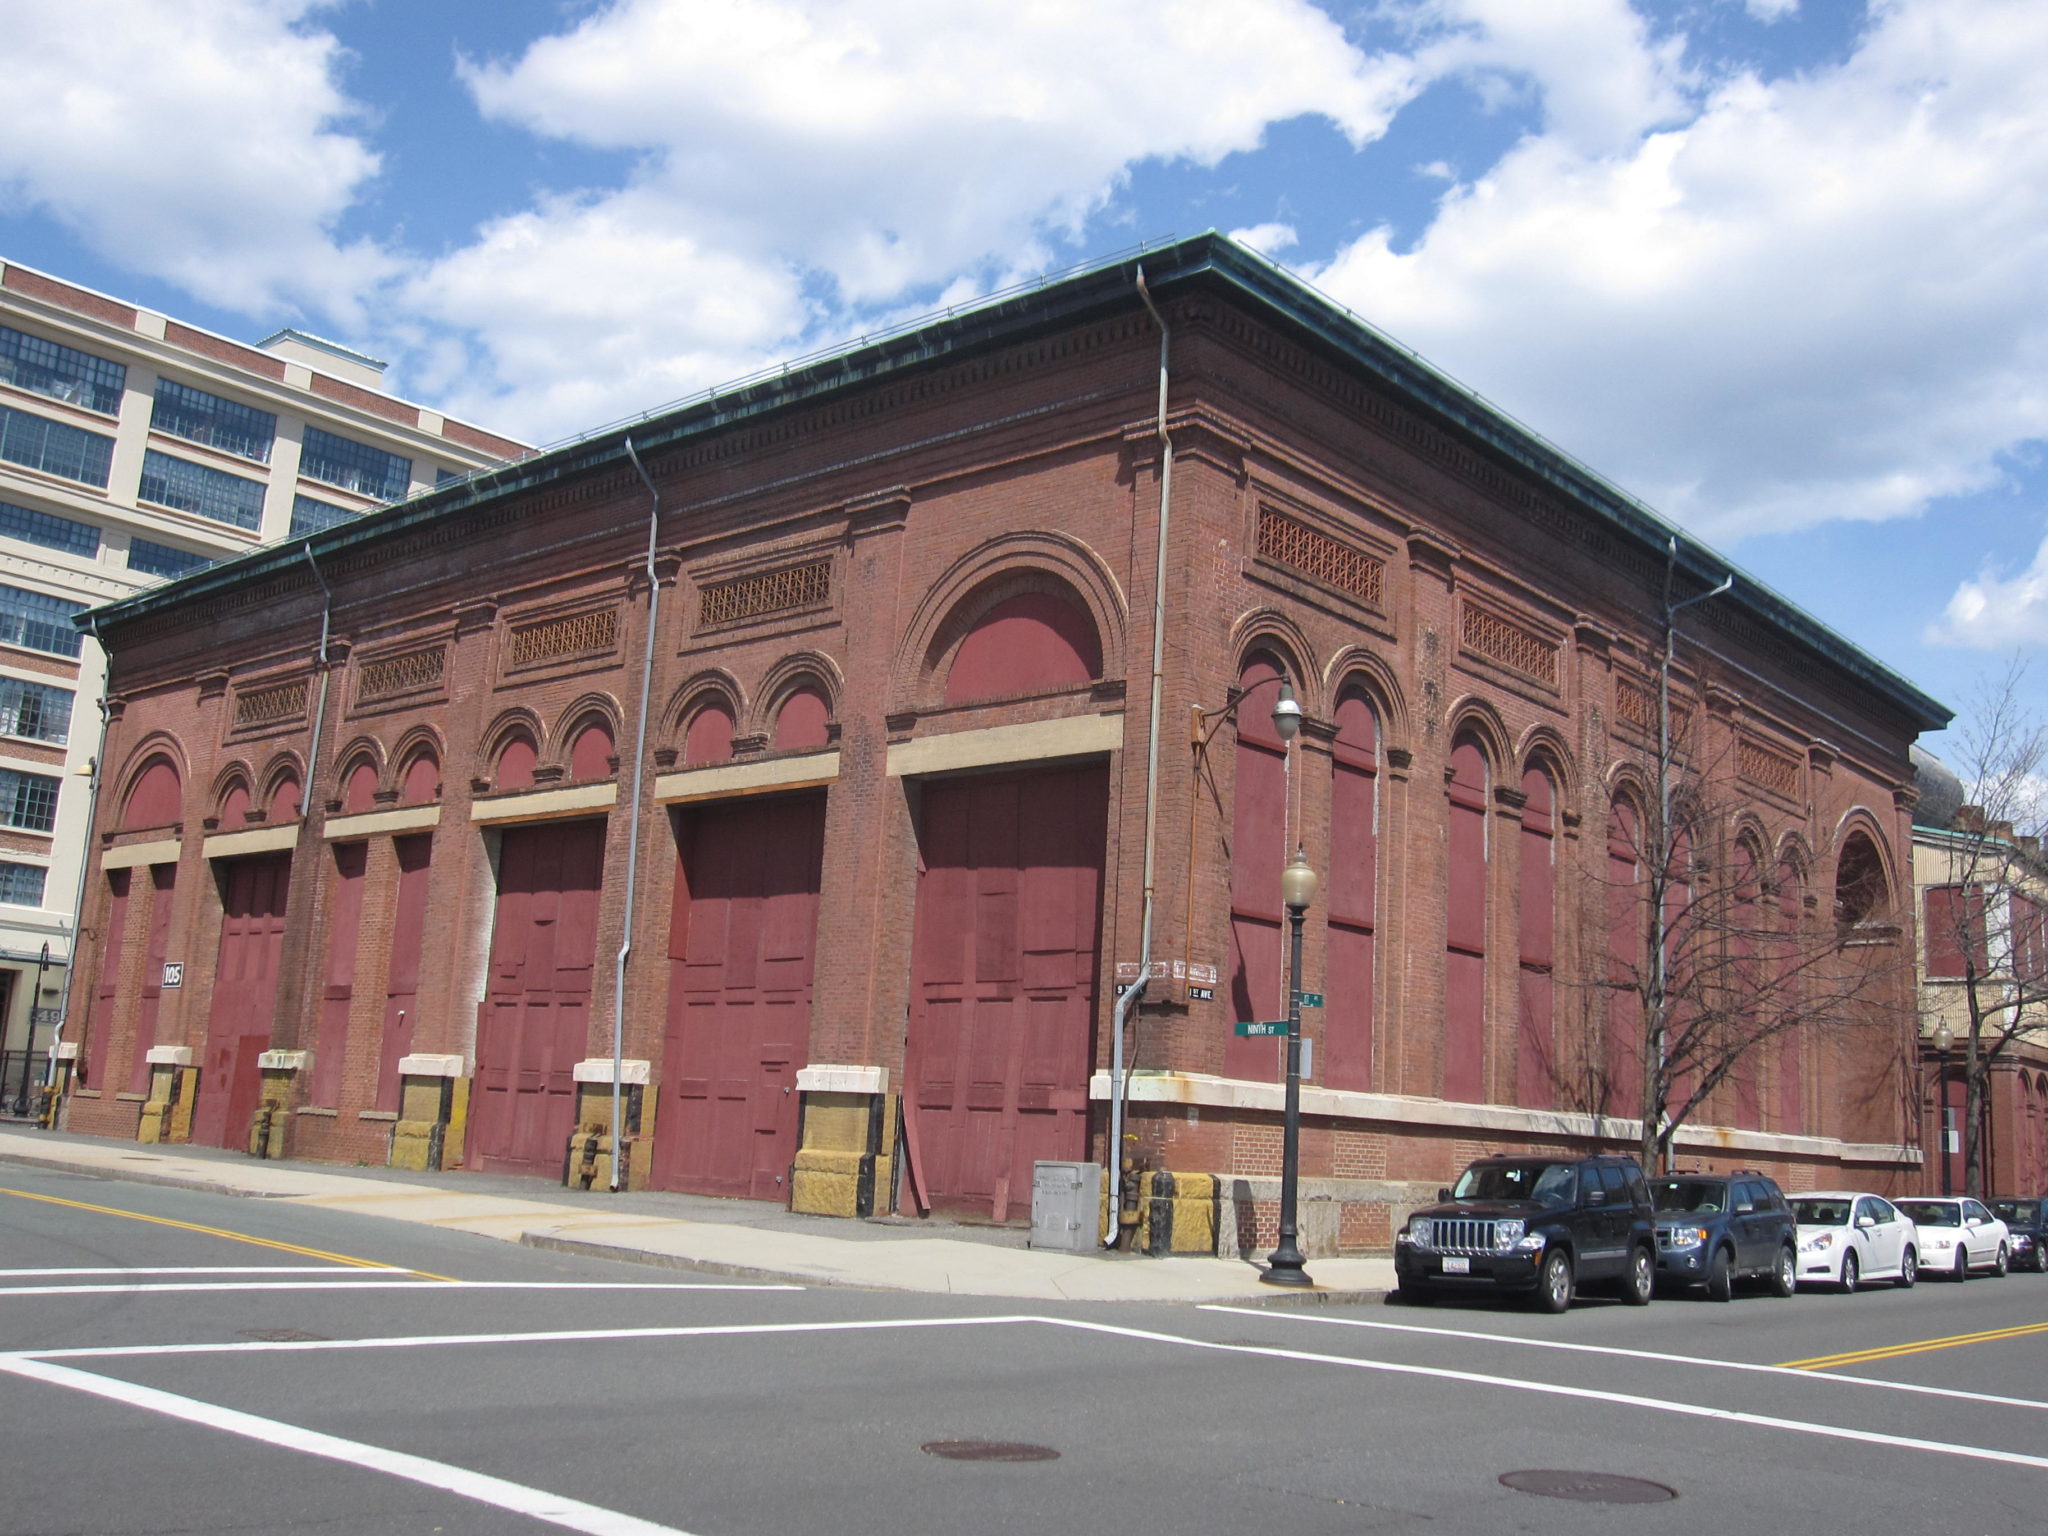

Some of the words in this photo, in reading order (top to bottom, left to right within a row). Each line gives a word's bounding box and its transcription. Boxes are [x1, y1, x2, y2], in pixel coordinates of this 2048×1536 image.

[165, 966, 181, 983] 105
[1248, 1024, 1266, 1035] NINTH
[1267, 1026, 1275, 1034] ST
